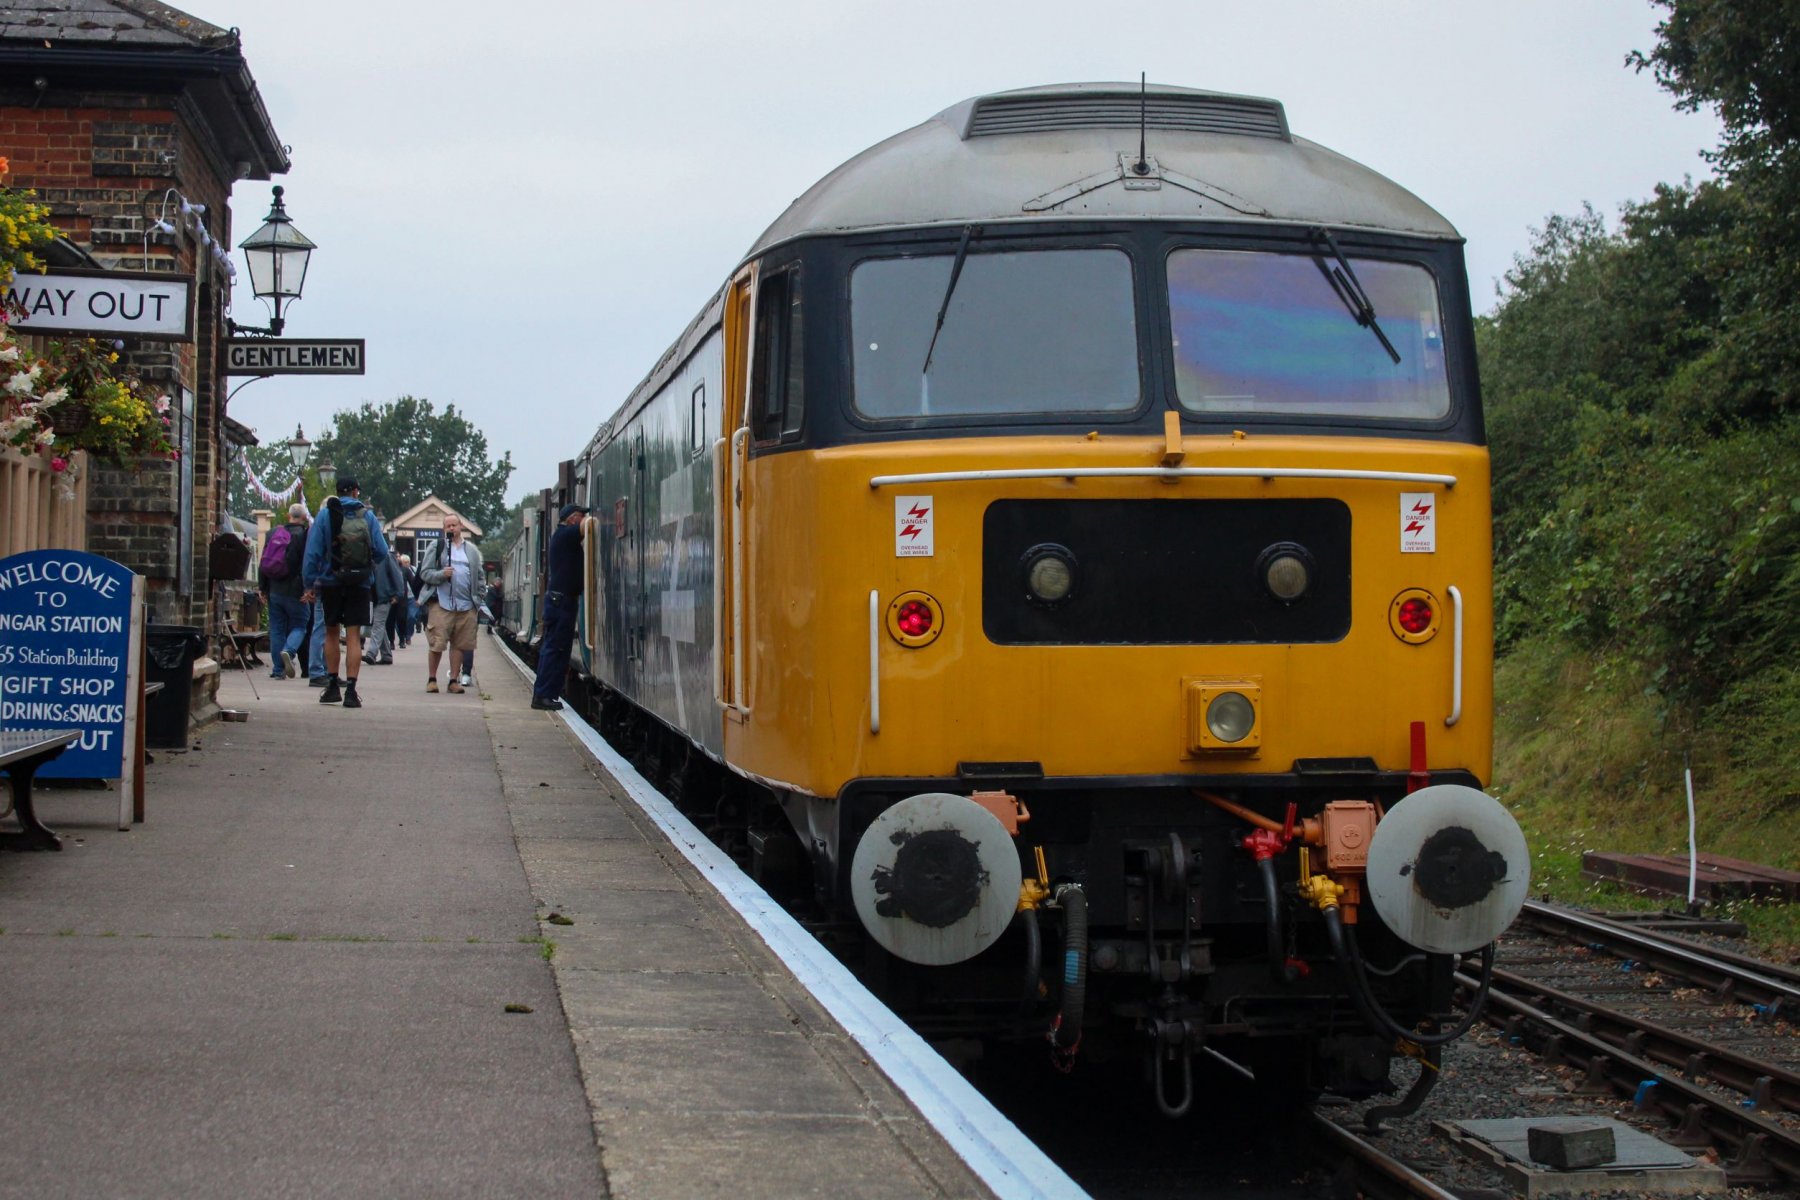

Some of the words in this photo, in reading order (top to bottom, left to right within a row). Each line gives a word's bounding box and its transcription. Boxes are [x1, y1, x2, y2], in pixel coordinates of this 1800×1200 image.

[88, 290, 170, 321] OUT
[231, 347, 357, 367] GENTLEMEN
[0, 560, 120, 599] WELCOME
[35, 591, 67, 607] TO
[51, 616, 122, 633] STATION
[19, 647, 65, 665] Station
[67, 648, 119, 673] Building
[4, 676, 53, 694] GIFT
[61, 677, 115, 696] SHOP
